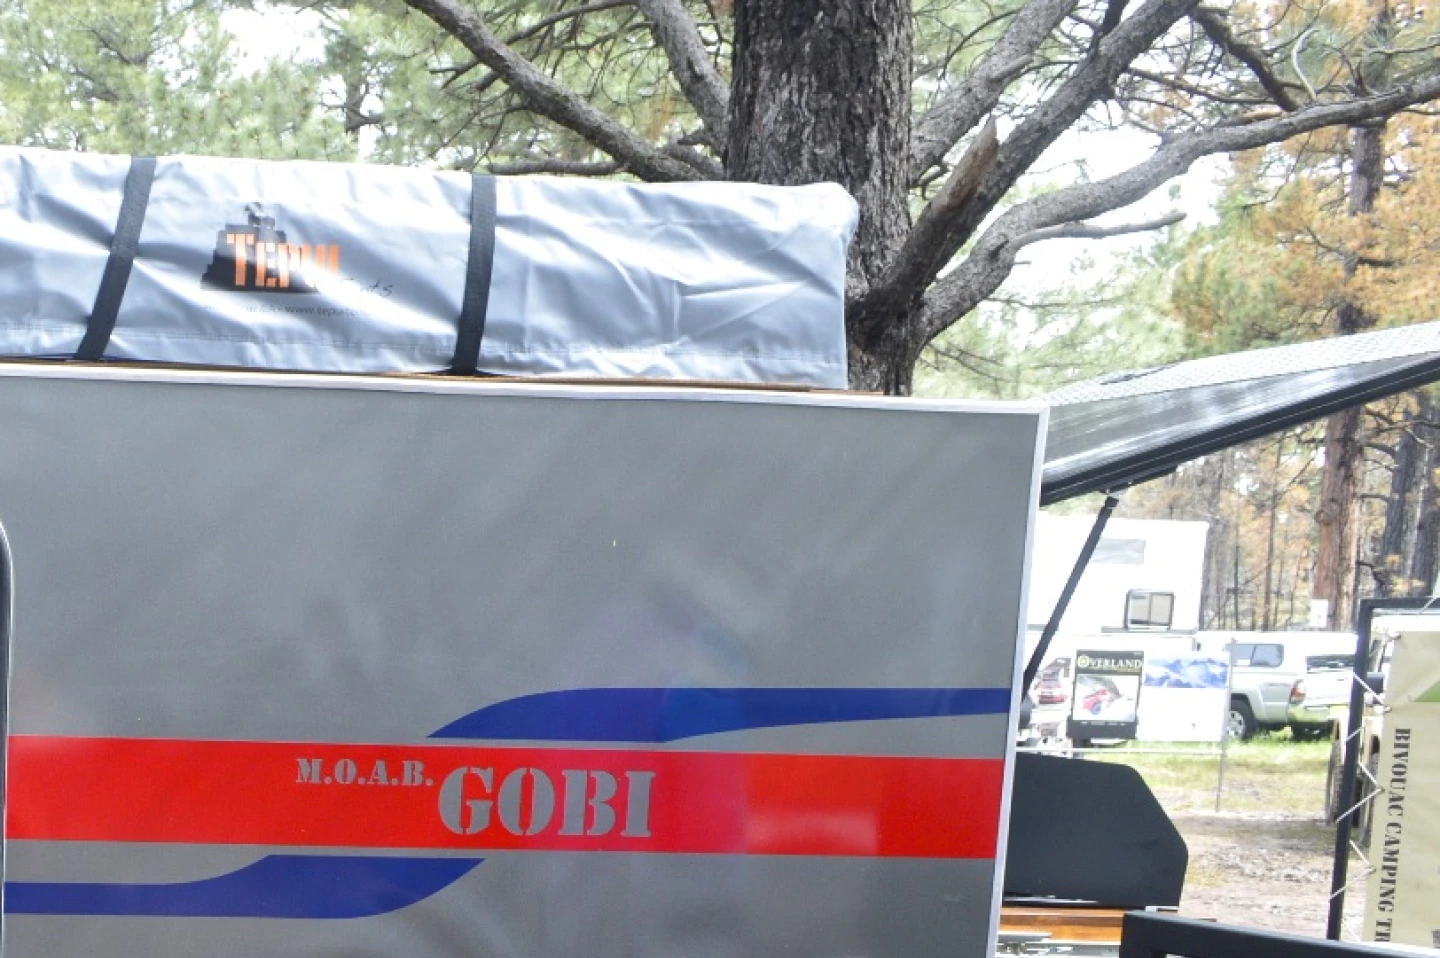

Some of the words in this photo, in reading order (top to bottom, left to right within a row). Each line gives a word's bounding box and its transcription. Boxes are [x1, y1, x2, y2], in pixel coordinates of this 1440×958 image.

[296, 758, 433, 786] M.O.A.B.
[438, 766, 656, 838] GOBI
[1387, 728, 1412, 817] BIVOUAC
[1377, 822, 1402, 913] CAMPING
